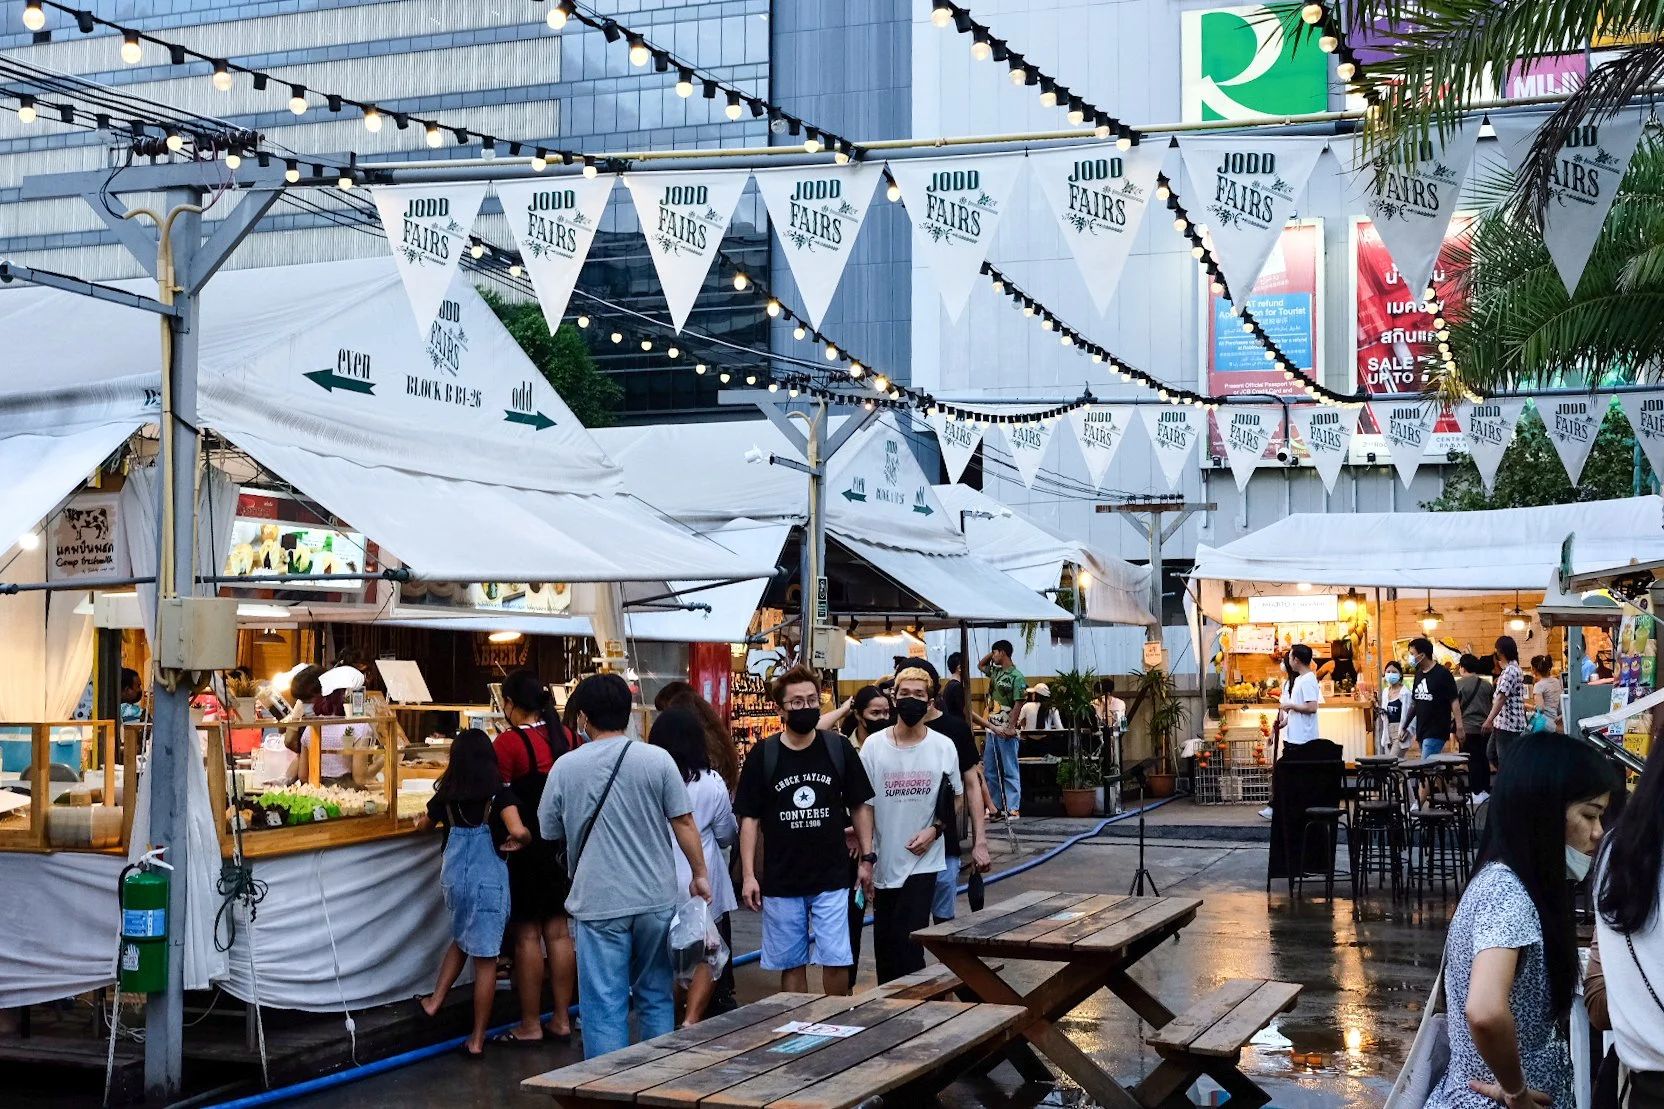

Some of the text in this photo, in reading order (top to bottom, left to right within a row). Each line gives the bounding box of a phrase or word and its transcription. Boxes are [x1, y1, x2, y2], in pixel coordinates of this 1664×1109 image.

[1067, 157, 1124, 182] JODD
[1216, 152, 1276, 175] JODD
[790, 179, 842, 201] JODD
[926, 170, 980, 193] JODD
[527, 189, 576, 212] JODD
[659, 185, 709, 206] JODD
[1067, 182, 1126, 226] FAIRS
[1215, 174, 1274, 223] FAIRS
[403, 197, 450, 219] JODD
[926, 193, 981, 237] FAIRS
[527, 211, 577, 254] FAIRS
[657, 205, 708, 250] FAIRS
[789, 201, 842, 245] FAIRS
[402, 218, 450, 260] FAIRS
[1279, 306, 1306, 316] Tourist
[430, 320, 461, 372] FAIRS
[337, 348, 371, 379] even
[1367, 356, 1414, 371] SALE
[406, 375, 443, 401] BLOCK
[445, 382, 453, 403] B
[1393, 371, 1414, 384] TO
[511, 381, 533, 412] odd
[1640, 399, 1664, 411] JOD
[1083, 412, 1112, 423] JODD
[1157, 411, 1186, 423] JODD
[1231, 413, 1260, 425] JODD
[1309, 412, 1339, 425] JODD
[1390, 408, 1420, 420] JODD
[1470, 405, 1500, 417] JODD
[1555, 402, 1586, 415] JODD
[1083, 423, 1112, 447] FAIRS
[1157, 423, 1186, 447] FAIRS
[1230, 424, 1259, 450] FAIRS
[1310, 425, 1341, 448] FAIRS
[1390, 420, 1420, 444] FAIRS
[1470, 417, 1502, 442] FAIRS
[1555, 415, 1588, 439] FAIRS
[774, 772, 832, 792] CHUCK TAYLOR
[779, 807, 830, 821] CONVERSE
